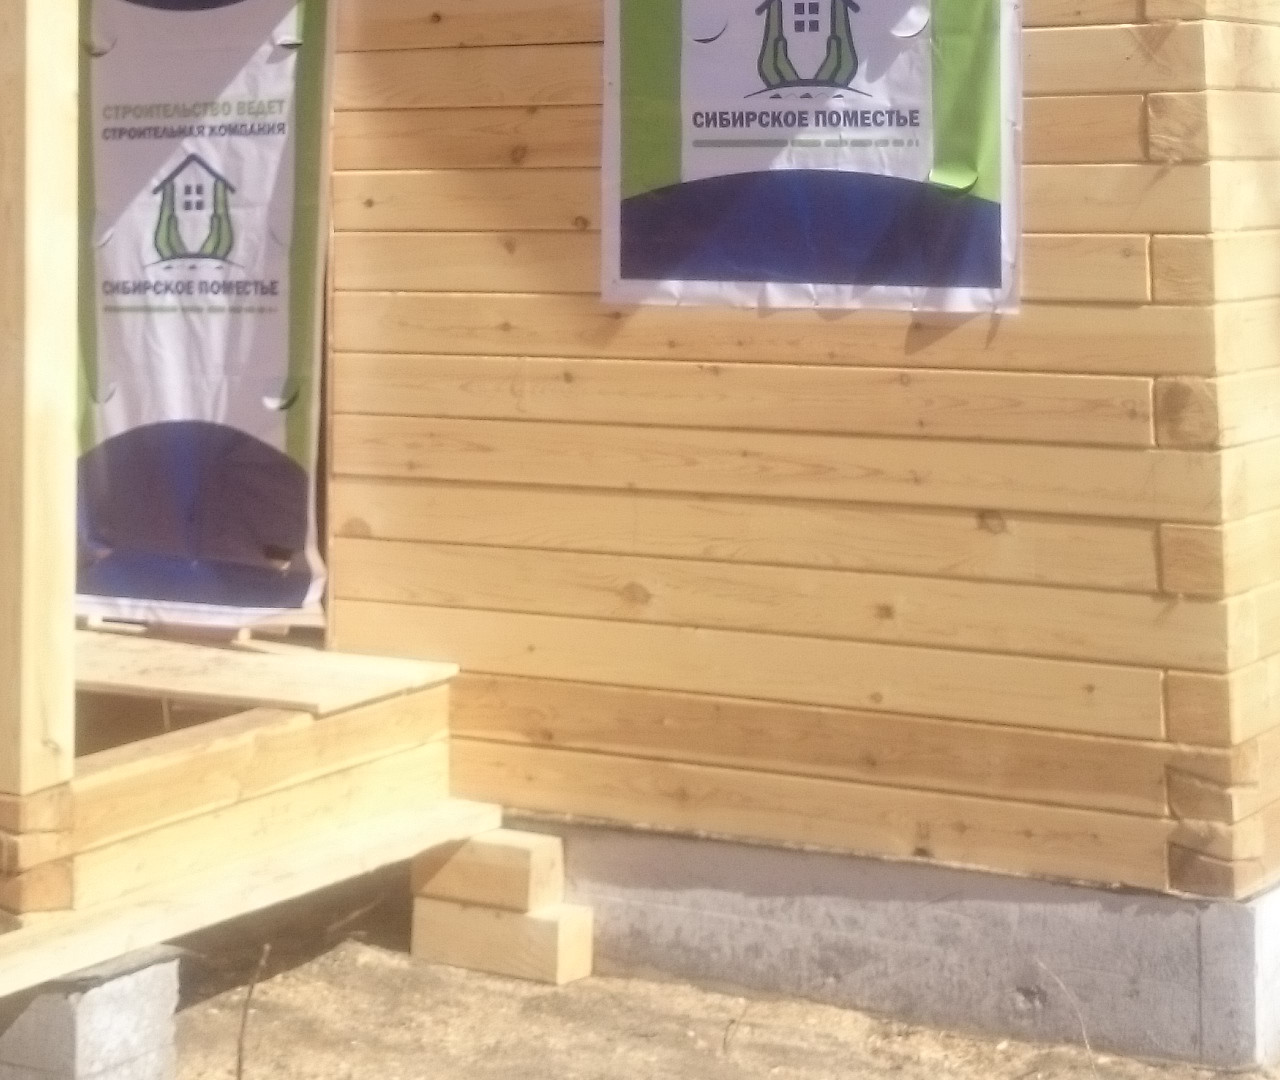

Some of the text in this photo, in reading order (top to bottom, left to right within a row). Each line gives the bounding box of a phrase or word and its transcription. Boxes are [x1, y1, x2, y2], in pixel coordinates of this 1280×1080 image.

[236, 99, 286, 118] ВЕДЕТ
[691, 109, 921, 129] СИБИРСКОЕ ПОМЕСТЬЕ
[101, 279, 280, 296] СИБИРСКОЕ ПОМЕСТЬЕ
